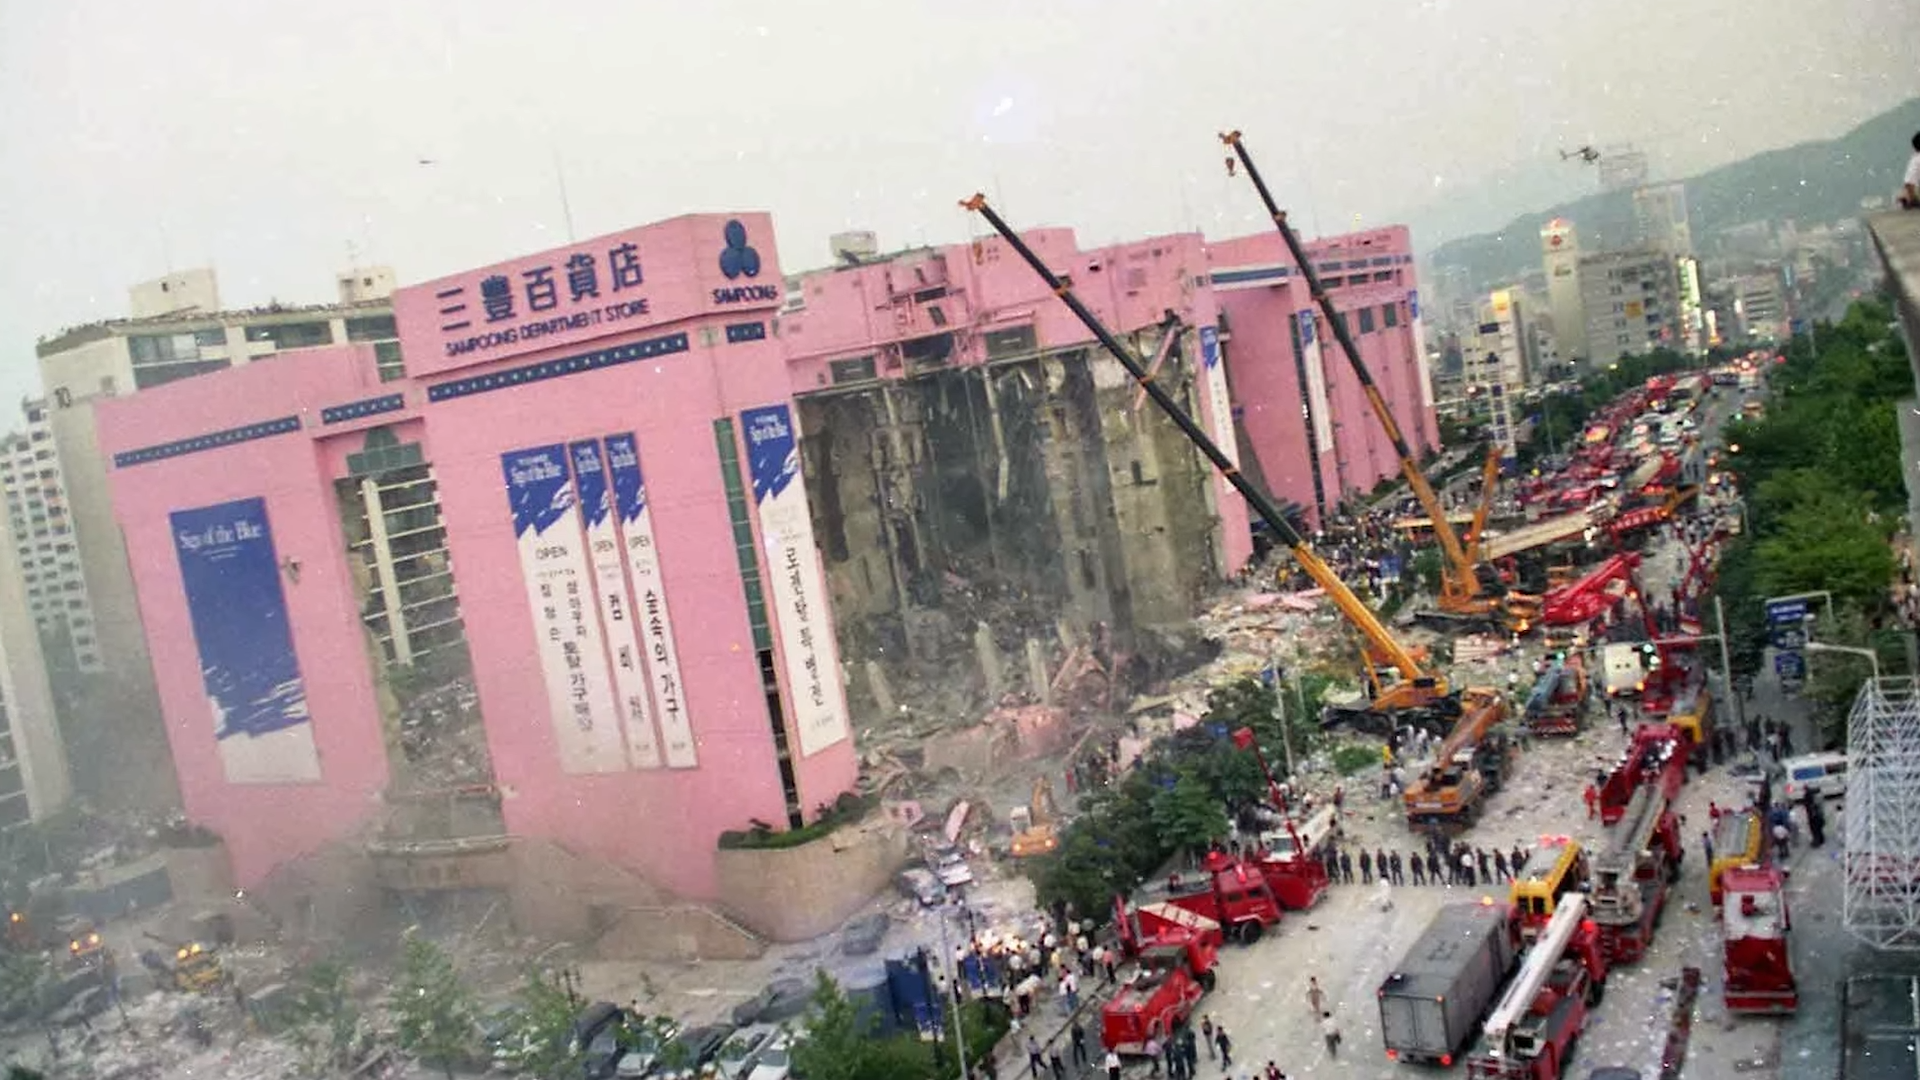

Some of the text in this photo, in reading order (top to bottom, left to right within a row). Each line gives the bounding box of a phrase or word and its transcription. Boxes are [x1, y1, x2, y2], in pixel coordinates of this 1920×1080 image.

[712, 284, 778, 304] SAMPOONG
[446, 298, 650, 357] SAMPOONG DEPARTMENT STORE
